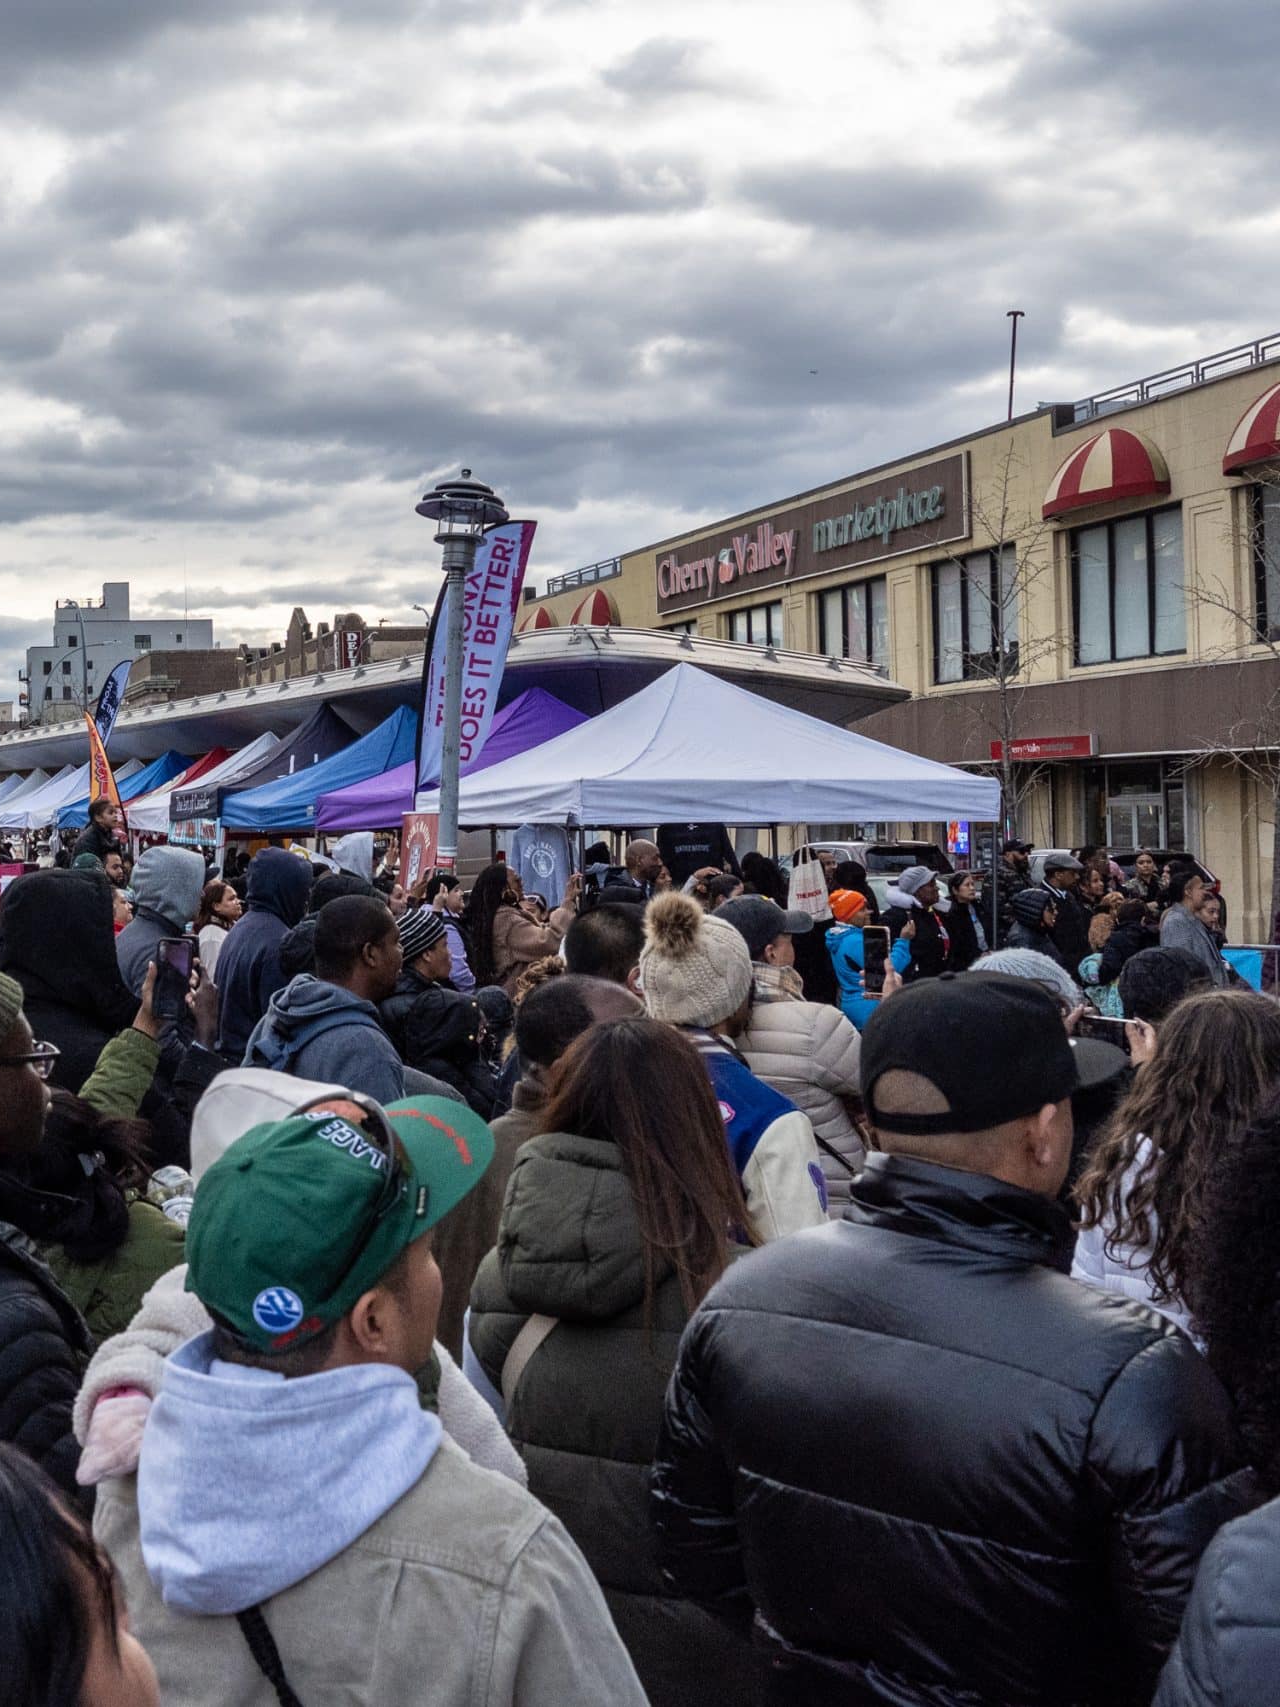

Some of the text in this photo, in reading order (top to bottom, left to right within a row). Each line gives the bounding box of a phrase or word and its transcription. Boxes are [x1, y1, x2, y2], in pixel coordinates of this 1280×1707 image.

[657, 485, 945, 598] Cherry Valley marketplace
[473, 537, 517, 646] BETTER!
[346, 632, 358, 668] DELI
[468, 652, 493, 678] IT
[317, 1119, 387, 1169] LACE
